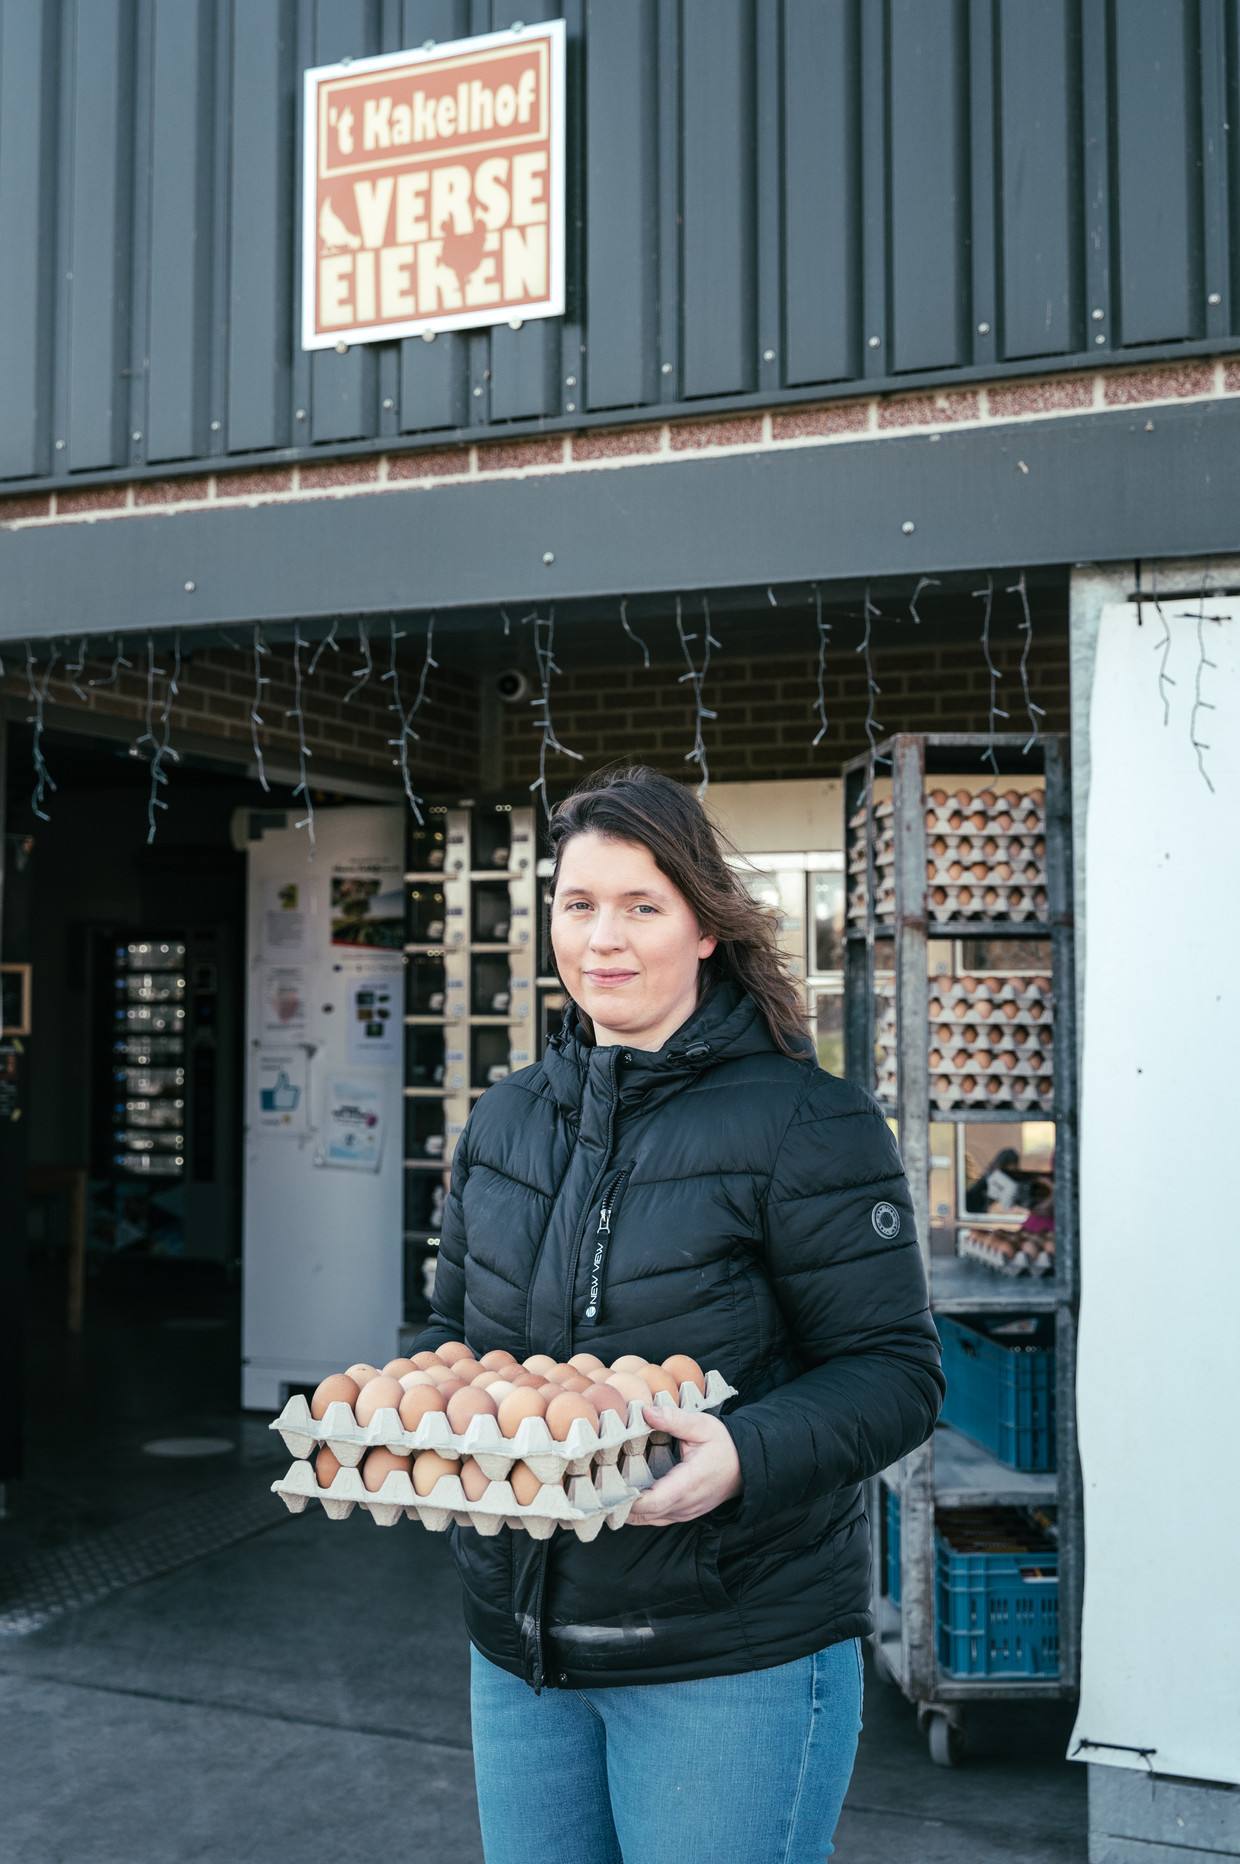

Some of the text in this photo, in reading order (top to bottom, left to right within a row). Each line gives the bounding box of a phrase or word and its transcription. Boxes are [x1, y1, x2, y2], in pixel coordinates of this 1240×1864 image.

[329, 67, 537, 155] 't Kakelhof
[353, 150, 549, 250] VERSE
[590, 1243, 604, 1304] NEW VIEW
